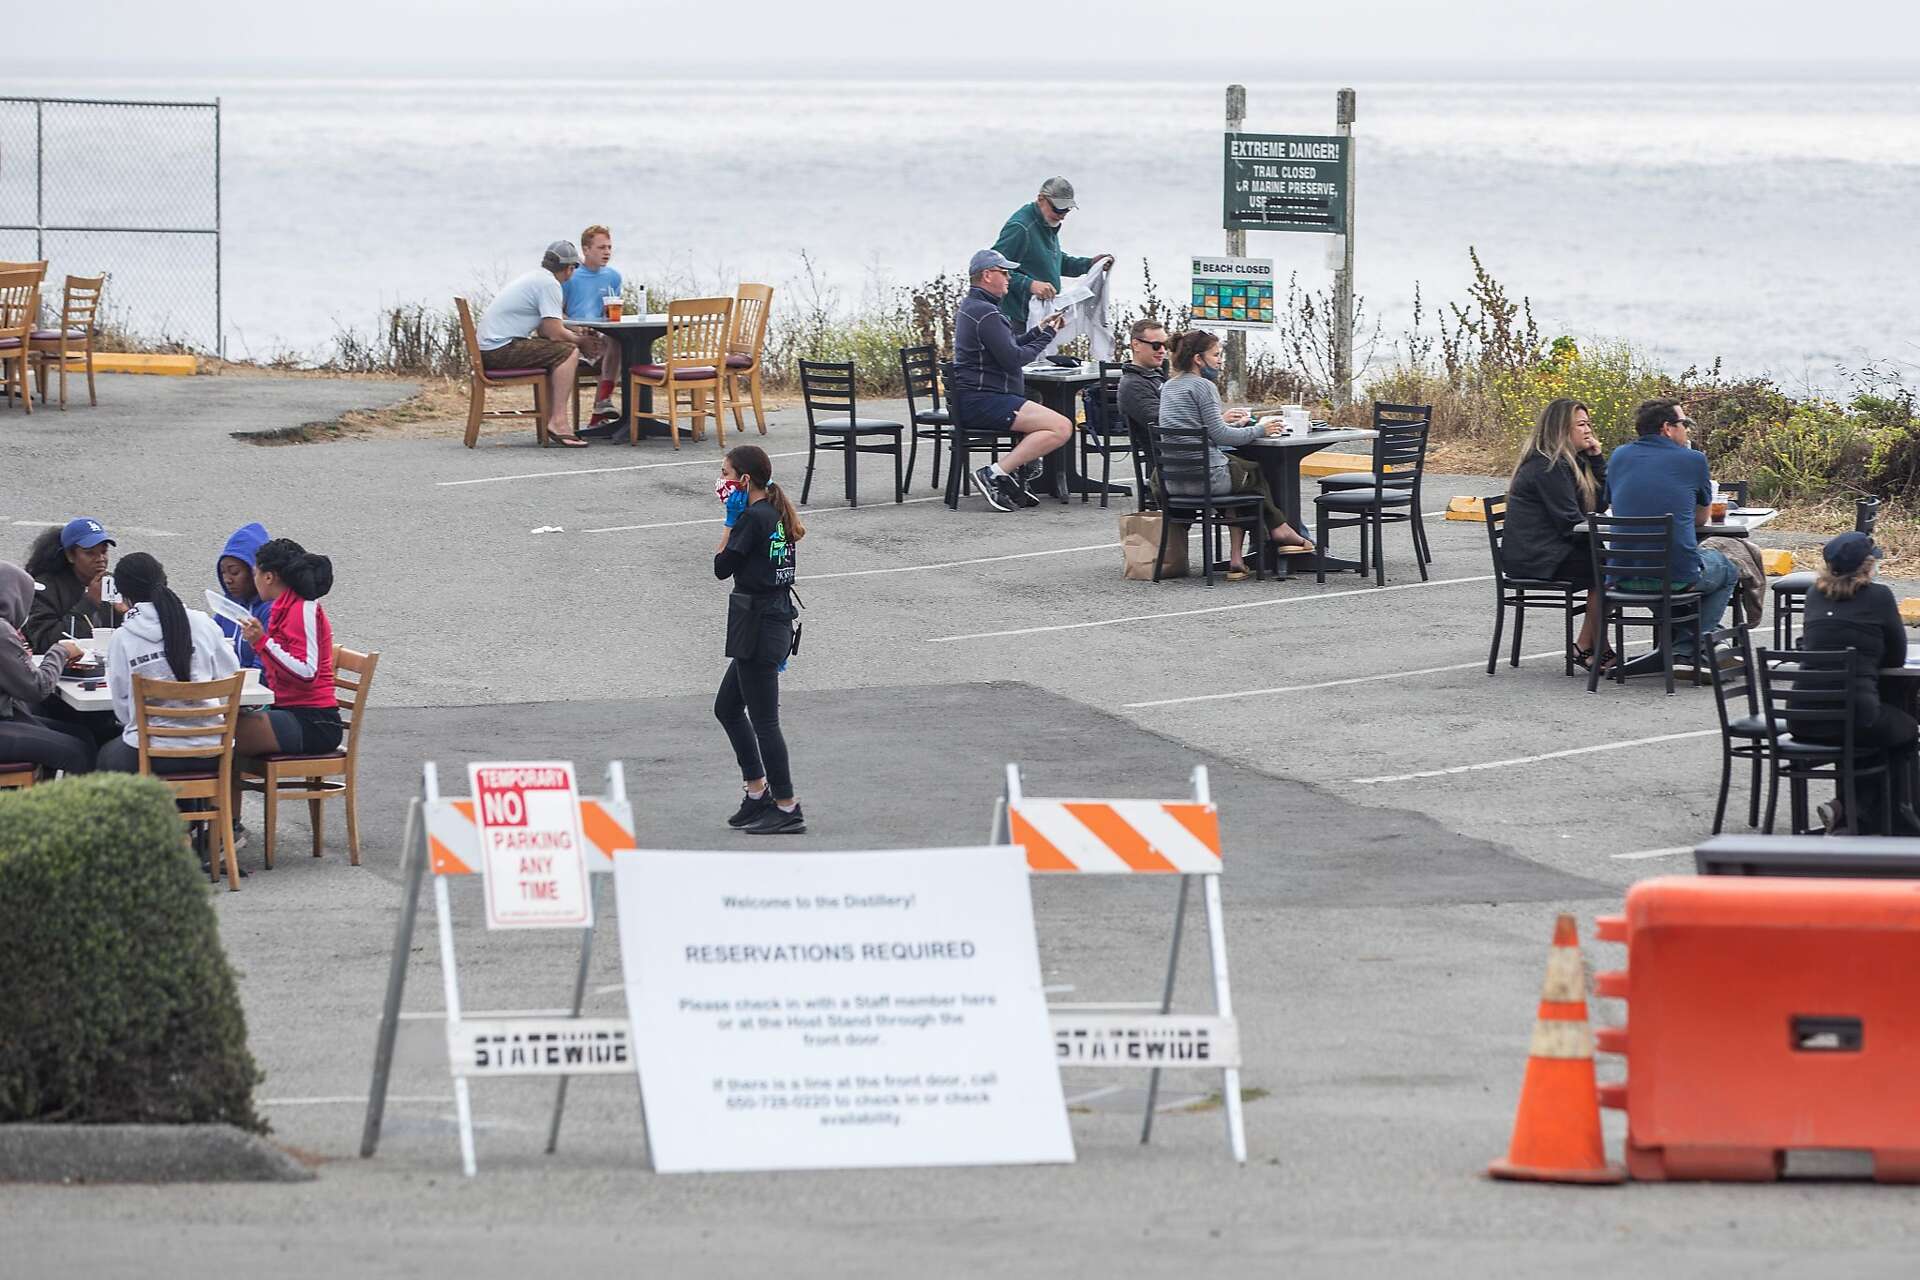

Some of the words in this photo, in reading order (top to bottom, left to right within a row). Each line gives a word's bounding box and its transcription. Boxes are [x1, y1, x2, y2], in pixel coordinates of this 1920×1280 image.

[1231, 140, 1285, 157] EXTREME
[1289, 142, 1339, 159] DANGER!
[1253, 165, 1279, 178] TRAIL
[1281, 166, 1316, 179] CLOSED
[1252, 180, 1286, 193] MARINE
[1288, 181, 1338, 197] PRESERVE,
[1249, 195, 1268, 208] USE
[1203, 263, 1233, 273] BEACH
[1235, 265, 1271, 274] CLOSED
[480, 769, 565, 788] TEMPORARY
[483, 791, 524, 825] NO
[493, 831, 572, 849] PARKING
[519, 856, 553, 875] ANY
[518, 880, 560, 900] TIME
[721, 894, 791, 910] Welcome
[796, 894, 811, 909] to
[815, 894, 840, 909] the
[844, 893, 917, 911] Distillery!
[685, 943, 855, 964] RESERVATIONS
[862, 940, 977, 961] REQUIRED
[679, 996, 730, 1012] Please
[735, 995, 781, 1011] check
[786, 996, 800, 1010] in
[804, 995, 837, 1010] with
[855, 994, 890, 1009] Staff
[894, 994, 956, 1009] member
[961, 993, 997, 1008] here
[717, 1017, 733, 1030] or
[739, 1015, 754, 1029] at
[758, 1014, 782, 1029] the
[787, 1014, 822, 1029] Host
[827, 1013, 872, 1028] Stand
[876, 1012, 936, 1030] through
[940, 1012, 964, 1026] the
[475, 1032, 628, 1067] STATEWIDE
[803, 1033, 841, 1047] front
[1056, 1029, 1211, 1060] STATEWIDE
[728, 1077, 768, 1091] there
[772, 1077, 786, 1090] is
[804, 1076, 832, 1090] line
[837, 1075, 852, 1089] at
[856, 1075, 880, 1089] the
[884, 1074, 921, 1088] front
[970, 1071, 998, 1086] call
[834, 1095, 850, 1108] to
[854, 1094, 900, 1108] check
[905, 1094, 920, 1107] in
[924, 1093, 940, 1106] or
[945, 1091, 991, 1106] check
